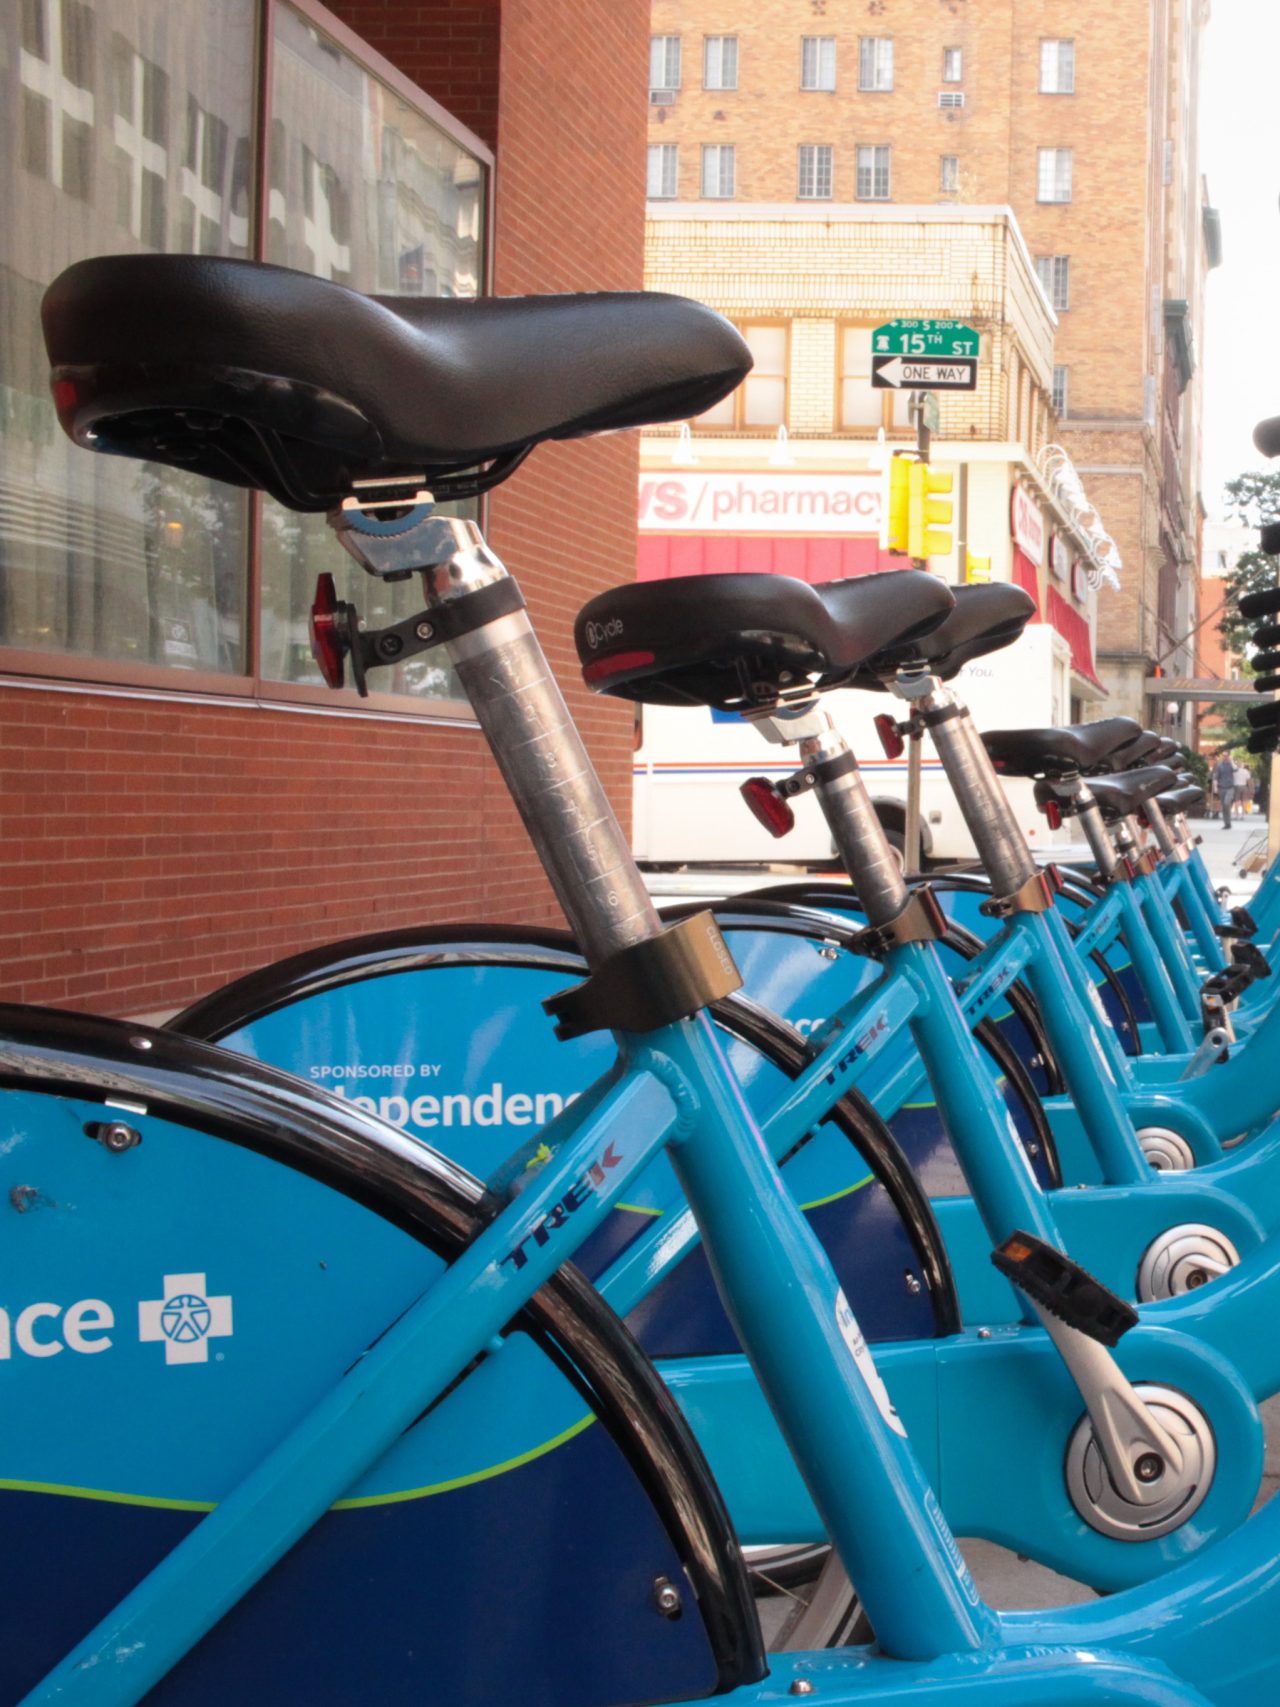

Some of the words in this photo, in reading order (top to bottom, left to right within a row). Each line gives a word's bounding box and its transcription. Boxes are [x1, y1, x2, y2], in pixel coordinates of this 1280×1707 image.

[902, 321, 918, 329] 300
[923, 320, 931, 331] S
[935, 322, 953, 330] 200
[900, 333, 943, 354] 15TH
[952, 341, 973, 355] ST
[903, 366, 931, 380] ONE
[937, 367, 966, 381] WAY
[706, 925, 734, 975] CLOSED
[965, 966, 1009, 1016] TREK
[820, 1012, 889, 1086] TREK
[309, 1065, 415, 1079] SPONSORED
[419, 1064, 442, 1077] BY
[501, 1139, 624, 1271] TREK
